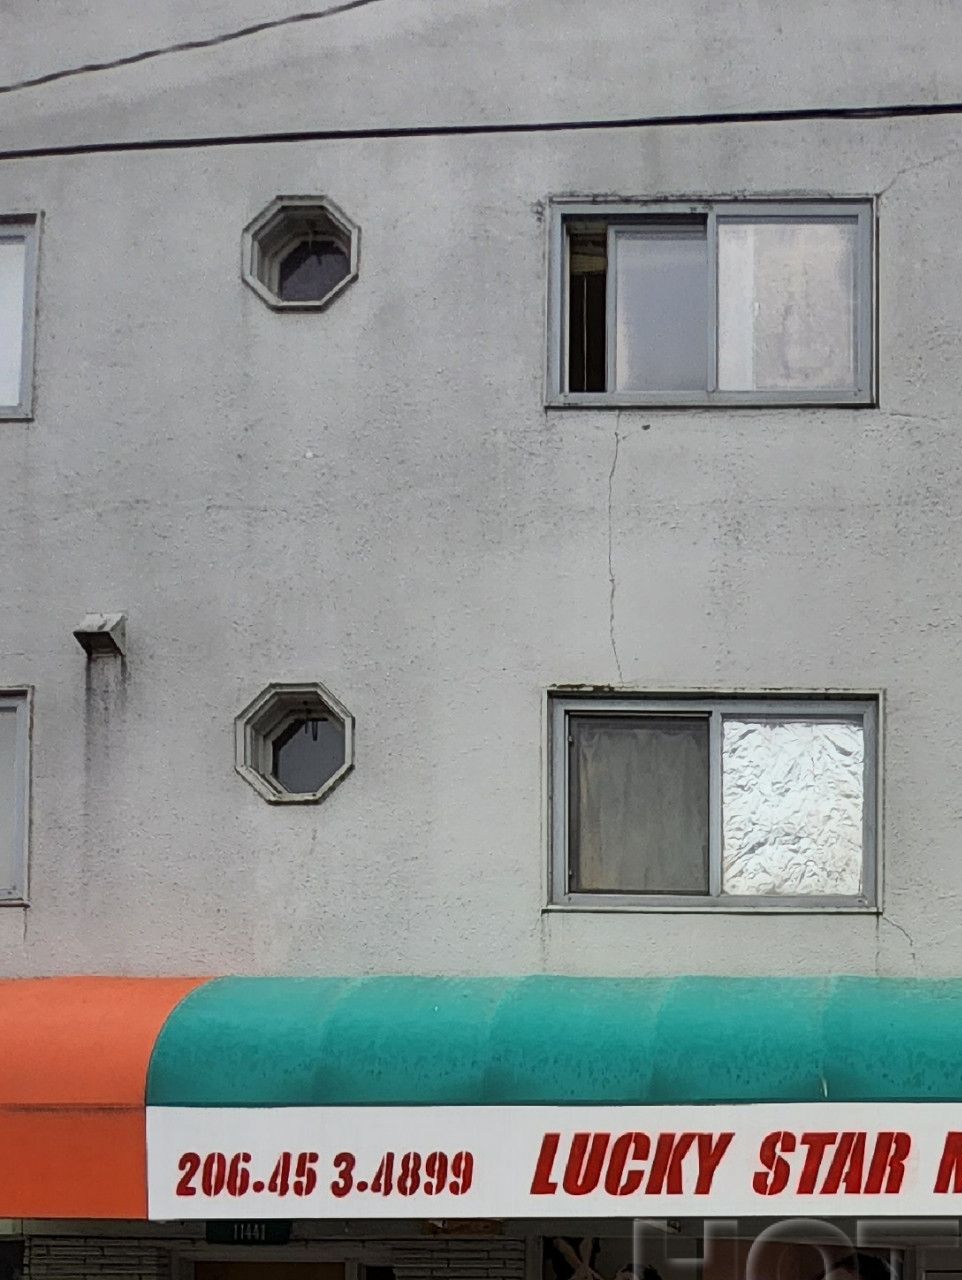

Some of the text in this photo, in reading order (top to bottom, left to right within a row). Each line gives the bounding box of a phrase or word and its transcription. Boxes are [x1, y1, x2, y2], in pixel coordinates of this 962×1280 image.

[529, 1131, 736, 1196] LUCKY
[752, 1130, 912, 1196] STAR
[233, 1223, 266, 1241] 11441
